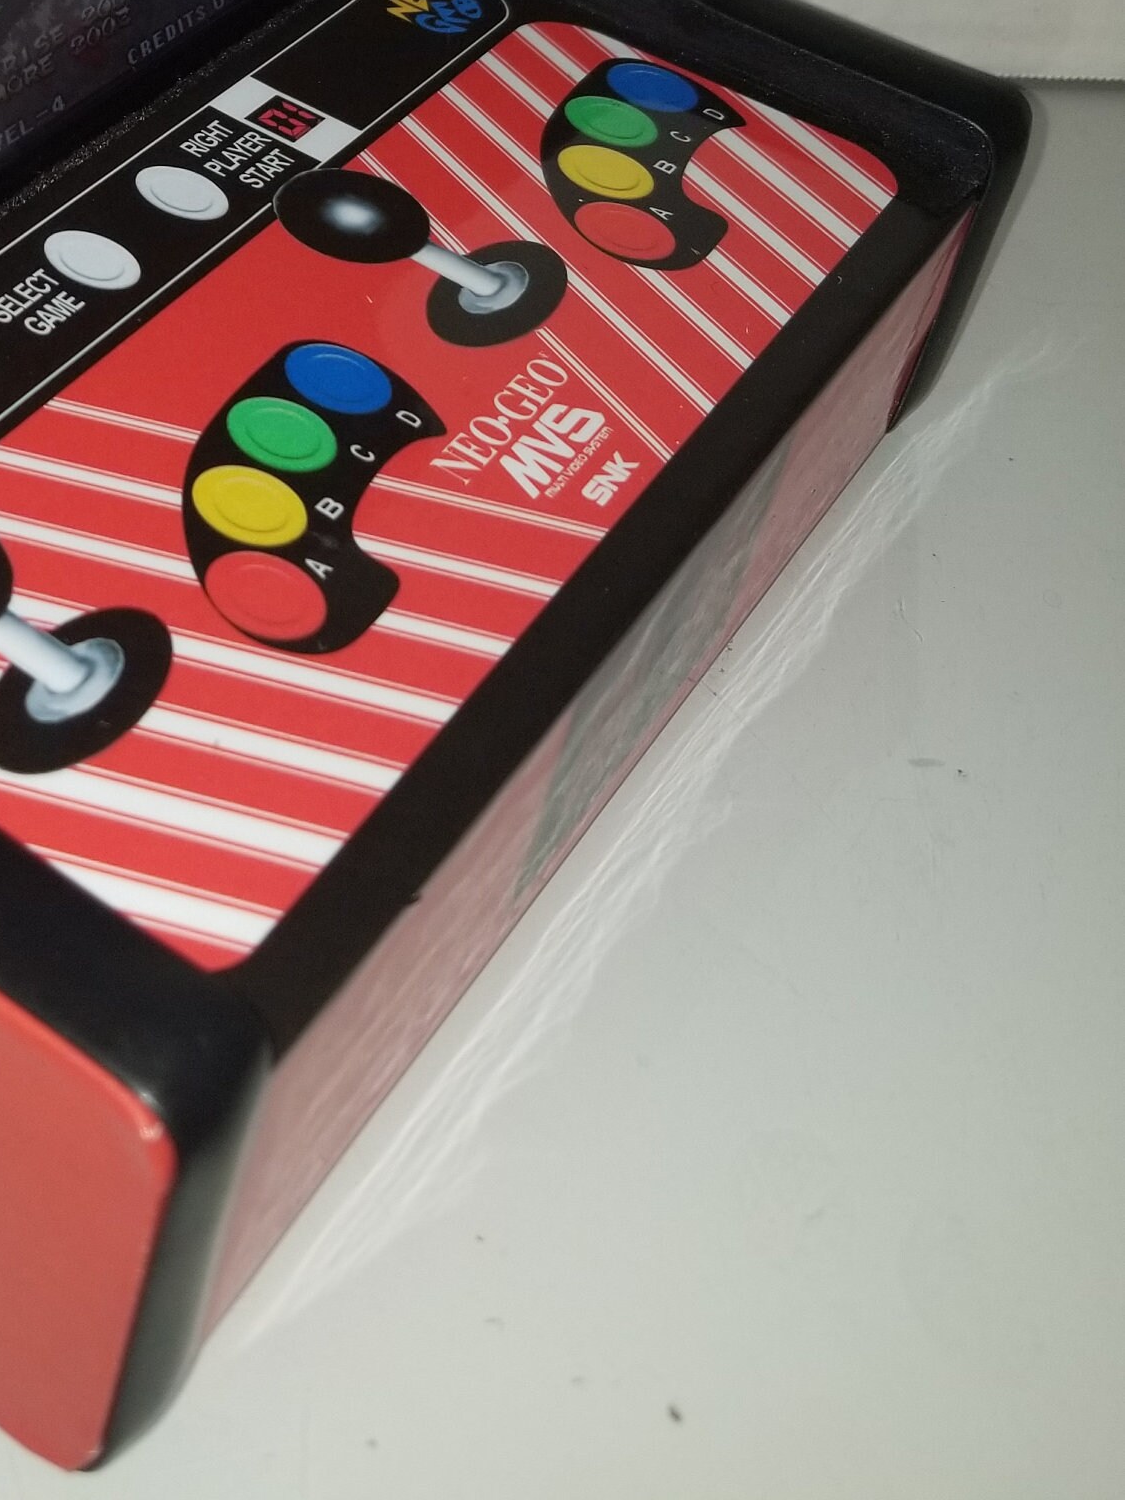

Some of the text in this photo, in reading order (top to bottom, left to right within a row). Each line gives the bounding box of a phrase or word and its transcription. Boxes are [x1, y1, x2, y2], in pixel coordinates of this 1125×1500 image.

[127, 4, 208, 66] CREDITS
[702, 107, 725, 121] D
[179, 119, 234, 158] RIGHT
[669, 130, 692, 143] C
[203, 131, 273, 177] PLAYER
[238, 148, 296, 189] START
[652, 159, 678, 175] B
[648, 206, 674, 221] A
[24, 290, 86, 336] GAME
[395, 409, 422, 429] D
[349, 443, 376, 463] C
[498, 402, 606, 500] MVS
[580, 450, 641, 507] SNK
[314, 496, 345, 521] B
[304, 557, 334, 580] A
